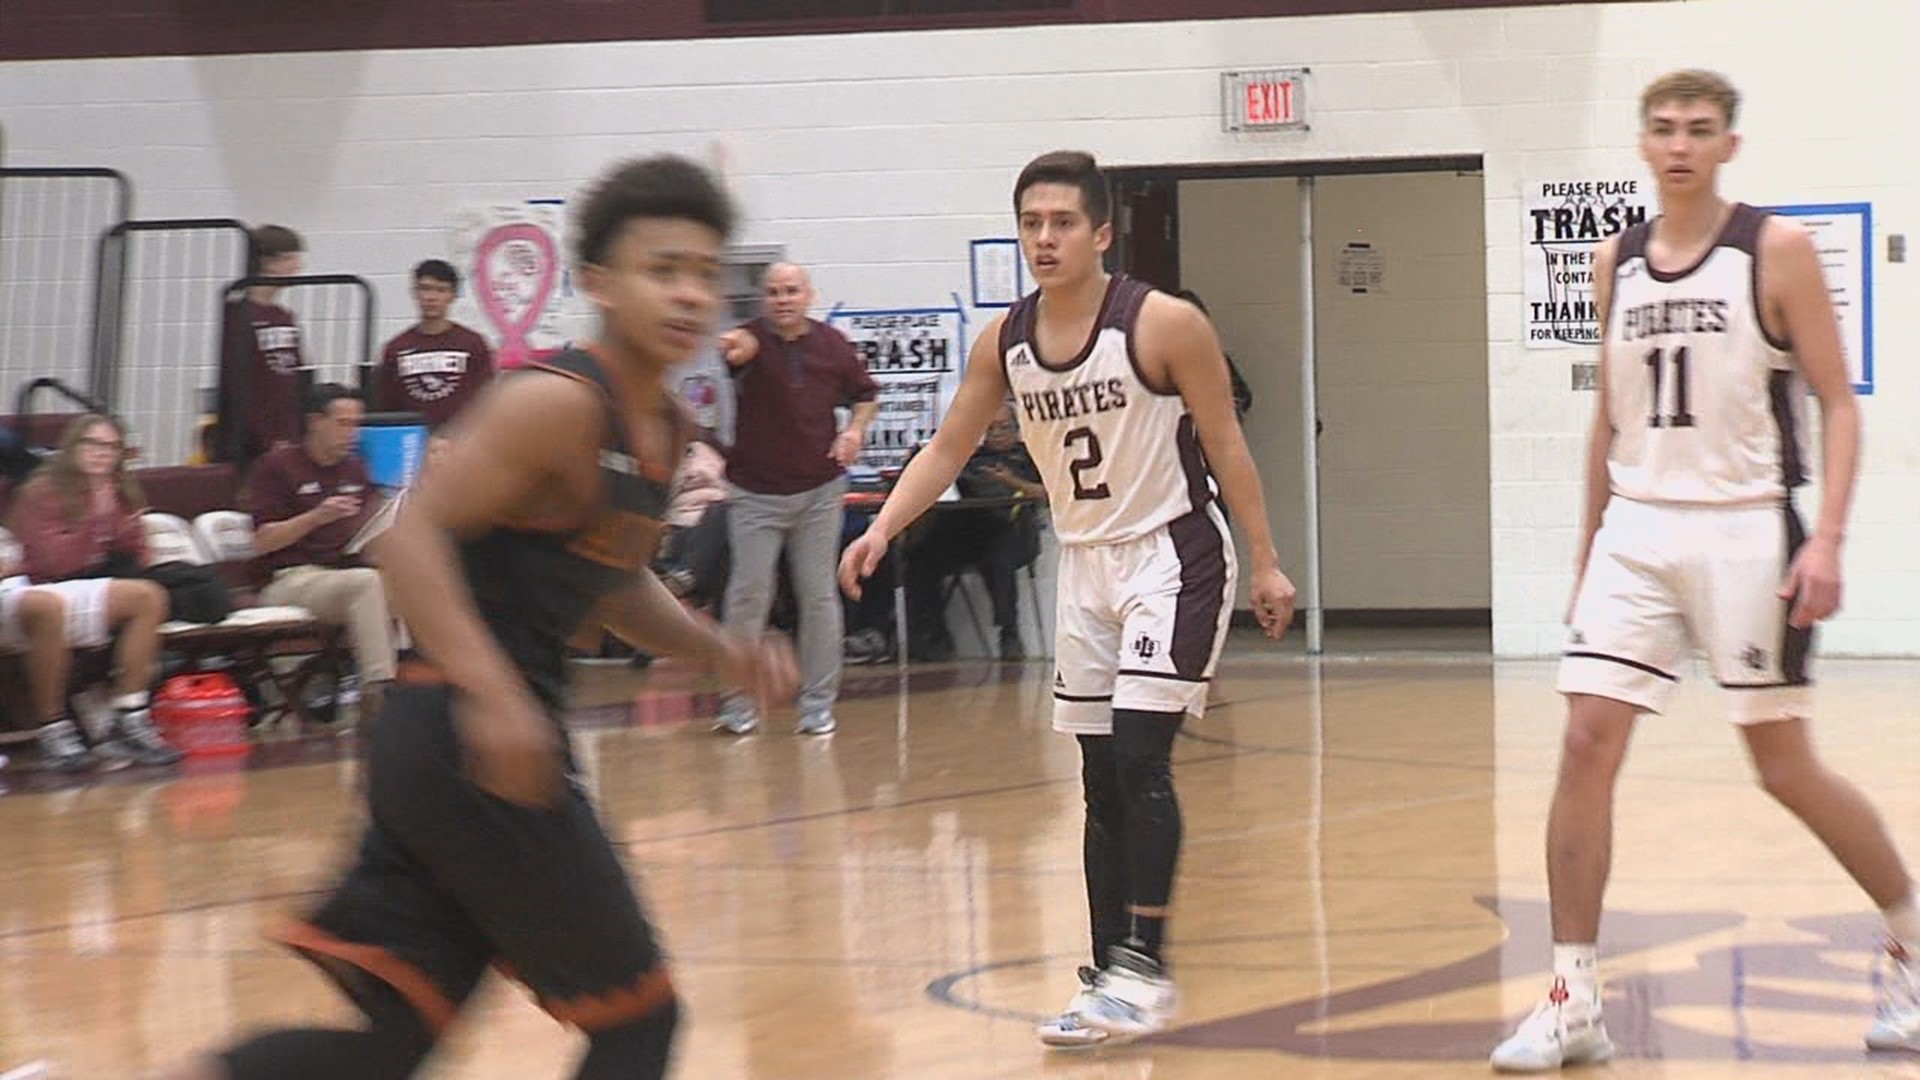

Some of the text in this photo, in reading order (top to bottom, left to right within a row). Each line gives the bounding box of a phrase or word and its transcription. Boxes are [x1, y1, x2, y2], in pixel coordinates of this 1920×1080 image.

[1247, 82, 1291, 120] EXIT
[1543, 181, 1637, 197] PLEASE PLACE
[1530, 206, 1645, 240] TRASH
[1562, 253, 1586, 266] THE
[1555, 271, 1595, 284] CONTA
[1530, 329, 1552, 340] FOR
[1622, 299, 1727, 341] PIRATES
[856, 338, 947, 369] RASH
[1021, 378, 1127, 421] PIRATES
[1644, 346, 1697, 428] 11
[1063, 426, 1111, 500] 2
